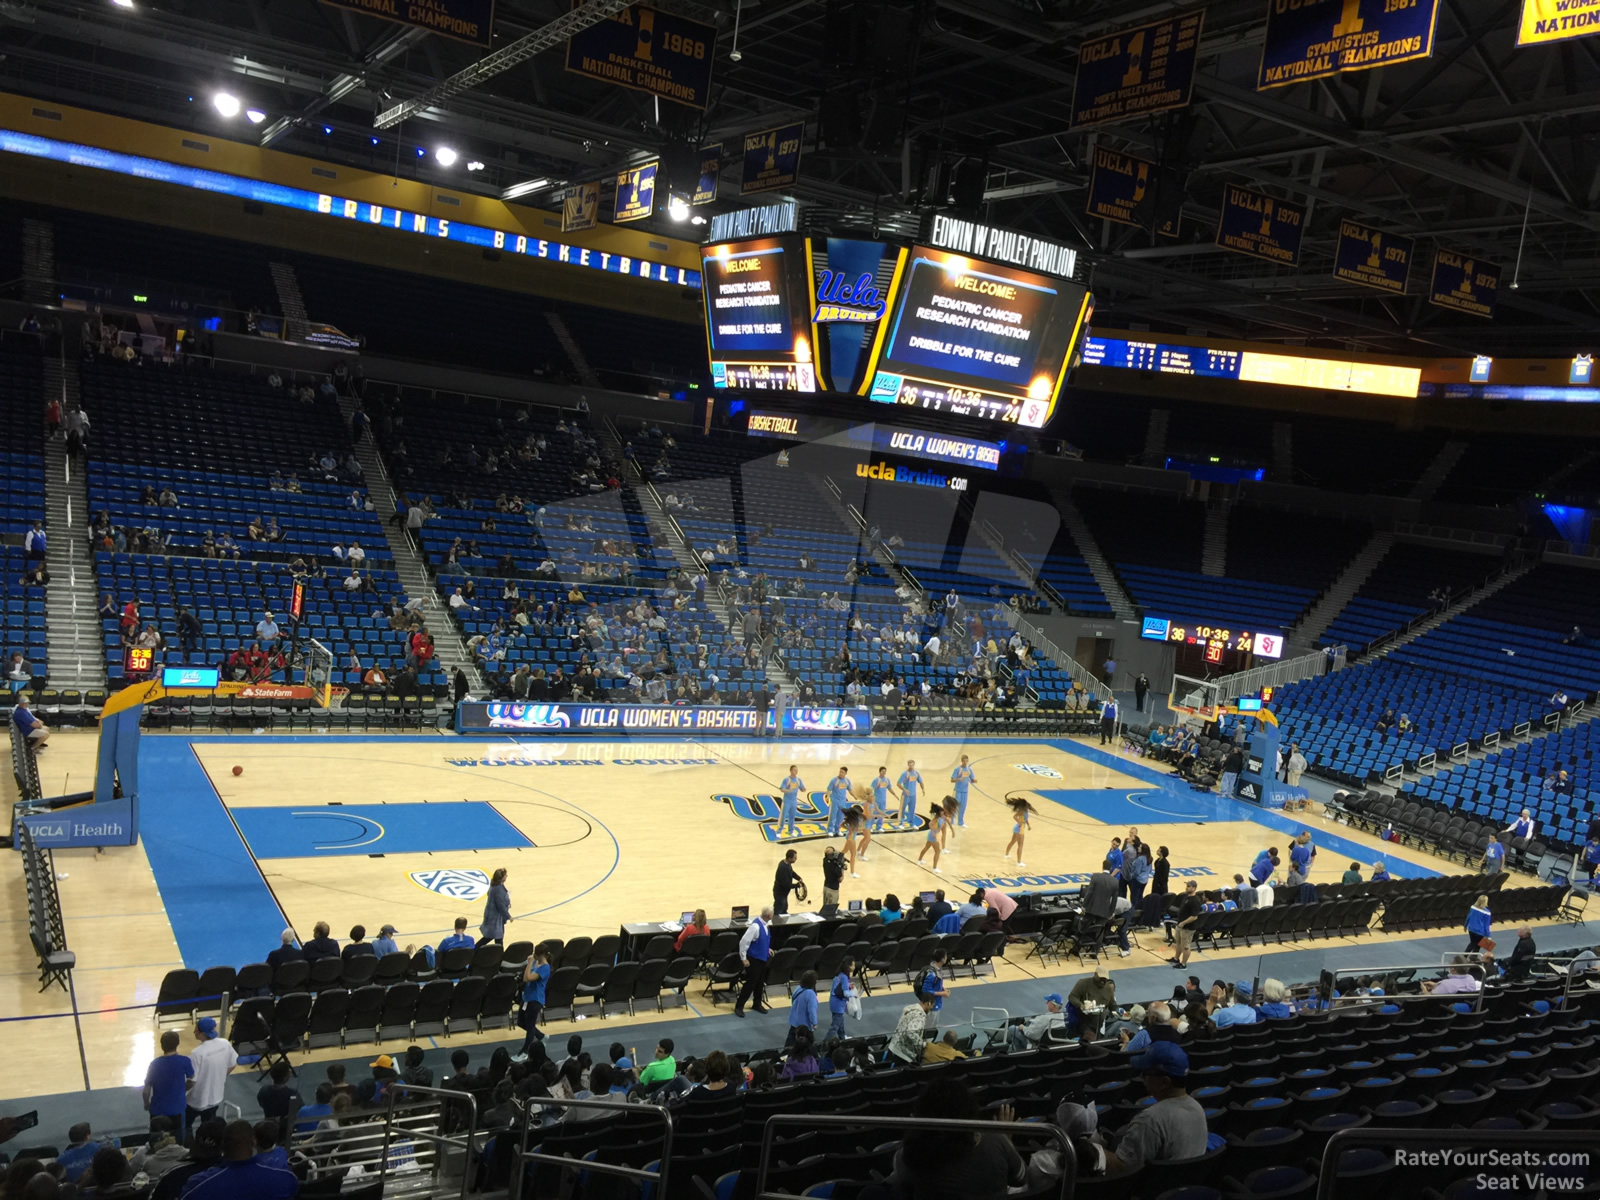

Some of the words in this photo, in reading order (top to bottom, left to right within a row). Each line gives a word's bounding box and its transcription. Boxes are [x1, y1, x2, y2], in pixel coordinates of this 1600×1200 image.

[407, 5, 478, 38] CHAMPIONS
[663, 32, 705, 60] 1968
[1080, 38, 1121, 65] UCLA
[1306, 30, 1379, 58] GYMNASTICS
[608, 52, 672, 80] BASKETBALL
[1265, 55, 1332, 82] NATIONAL
[1337, 35, 1421, 66] CHAMPIONS
[582, 56, 633, 82] NATIONAL
[636, 72, 696, 101] CHAMPIONS
[1077, 101, 1124, 122] NATIONAL
[1125, 88, 1181, 111] CHAMPIONS
[777, 139, 799, 156] 1973
[1097, 150, 1133, 176] UCLA
[1230, 189, 1263, 213] UCLA
[758, 203, 796, 236] PAVILION
[1277, 207, 1301, 227] 1970
[317, 194, 450, 238] BRUINS
[493, 230, 690, 286] BASKETBALL
[1343, 223, 1369, 242] UCLA
[932, 214, 975, 254] EDWIN
[974, 223, 989, 256] W
[987, 228, 1032, 267] PAULEY
[1029, 238, 1077, 279] PAVILION
[1224, 234, 1257, 252] NATIONAL
[1258, 244, 1294, 262] CHAMPIONS
[1384, 247, 1407, 264] 1971
[1439, 251, 1462, 269] UCLA
[954, 275, 1018, 300] WELCOME:
[1475, 272, 1497, 290] 1972
[816, 306, 878, 321] BRUINS
[931, 294, 982, 316] PEDIATRIC
[982, 306, 1023, 325] CANCER
[916, 307, 971, 328] RESEARCH
[970, 319, 1031, 341] FOUNDATION
[909, 335, 953, 355] DRIBBLE
[952, 344, 974, 359] FOR
[974, 349, 994, 363] THE
[993, 353, 1021, 368] CURE
[901, 385, 919, 406] 36
[946, 387, 981, 407] 10:36
[1002, 403, 1021, 424] 24
[755, 416, 798, 435] BASKETBALL
[890, 431, 925, 452] UCLA
[925, 437, 976, 461] WOMEN'S
[1170, 627, 1186, 642] 36
[1195, 627, 1230, 641] 10:36
[1236, 638, 1252, 652] 24
[132, 658, 148, 669] 30
[1206, 647, 1221, 661] 30
[579, 708, 620, 727] UCLA
[622, 708, 693, 728] WOMEN'S
[446, 758, 605, 767] WOODEN
[612, 758, 720, 766] COURT
[28, 825, 64, 838] UCLA
[73, 823, 123, 837] Health
